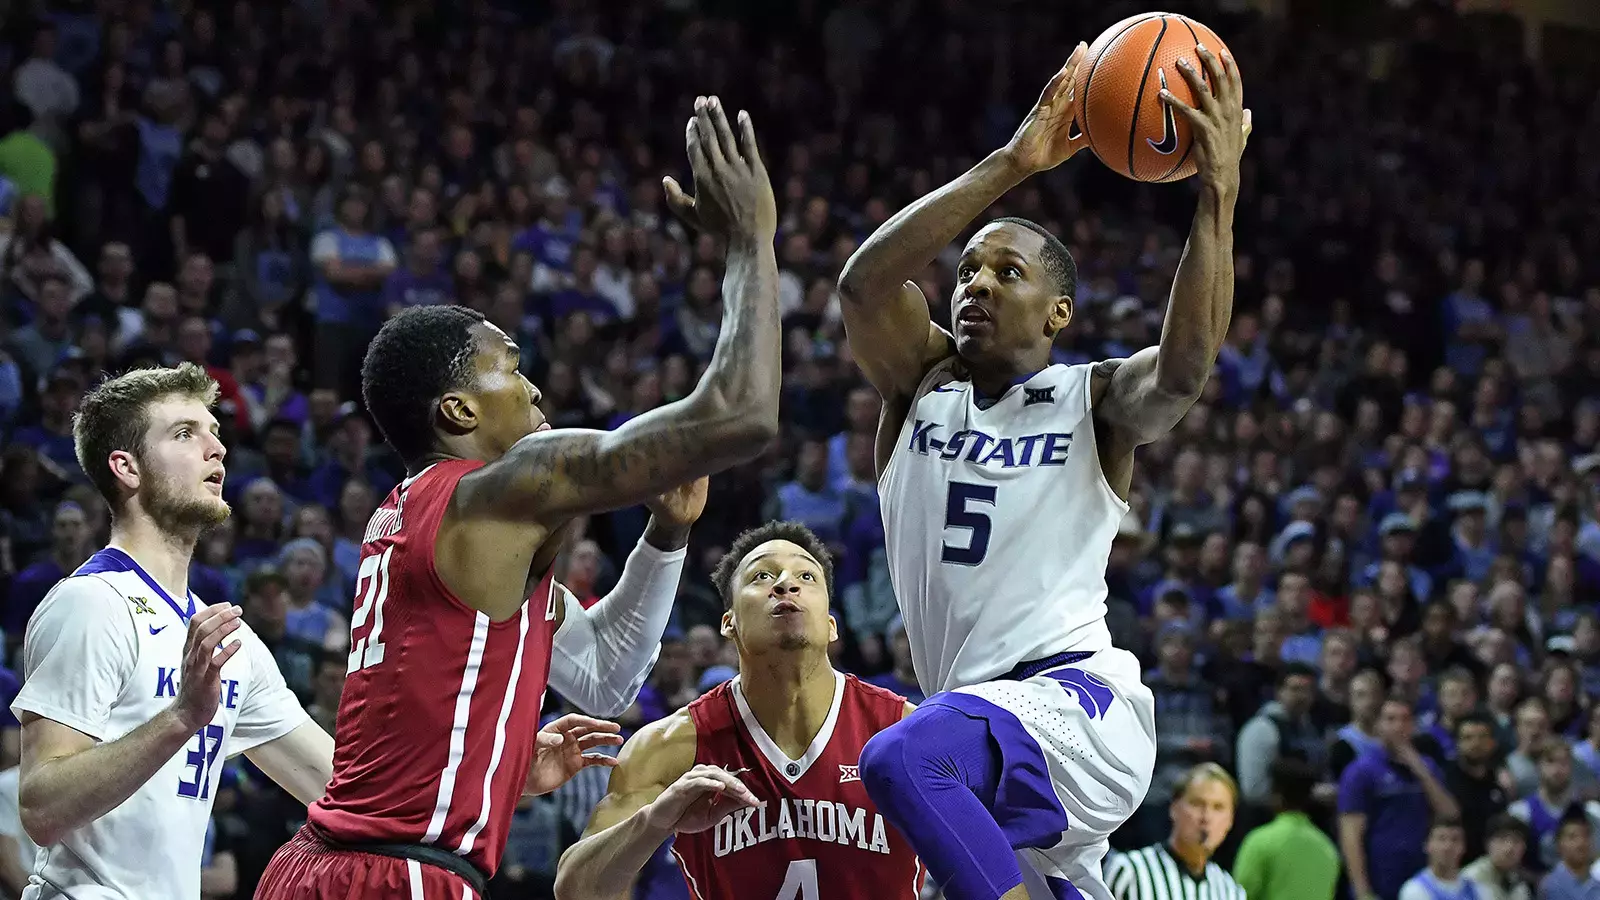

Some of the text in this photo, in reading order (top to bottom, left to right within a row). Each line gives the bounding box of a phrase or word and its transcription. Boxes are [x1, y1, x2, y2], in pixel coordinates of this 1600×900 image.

[908, 419, 1074, 469] K-STATE
[940, 480, 999, 568] 5
[345, 543, 396, 678] 21
[714, 797, 891, 858] OKLAHOMA
